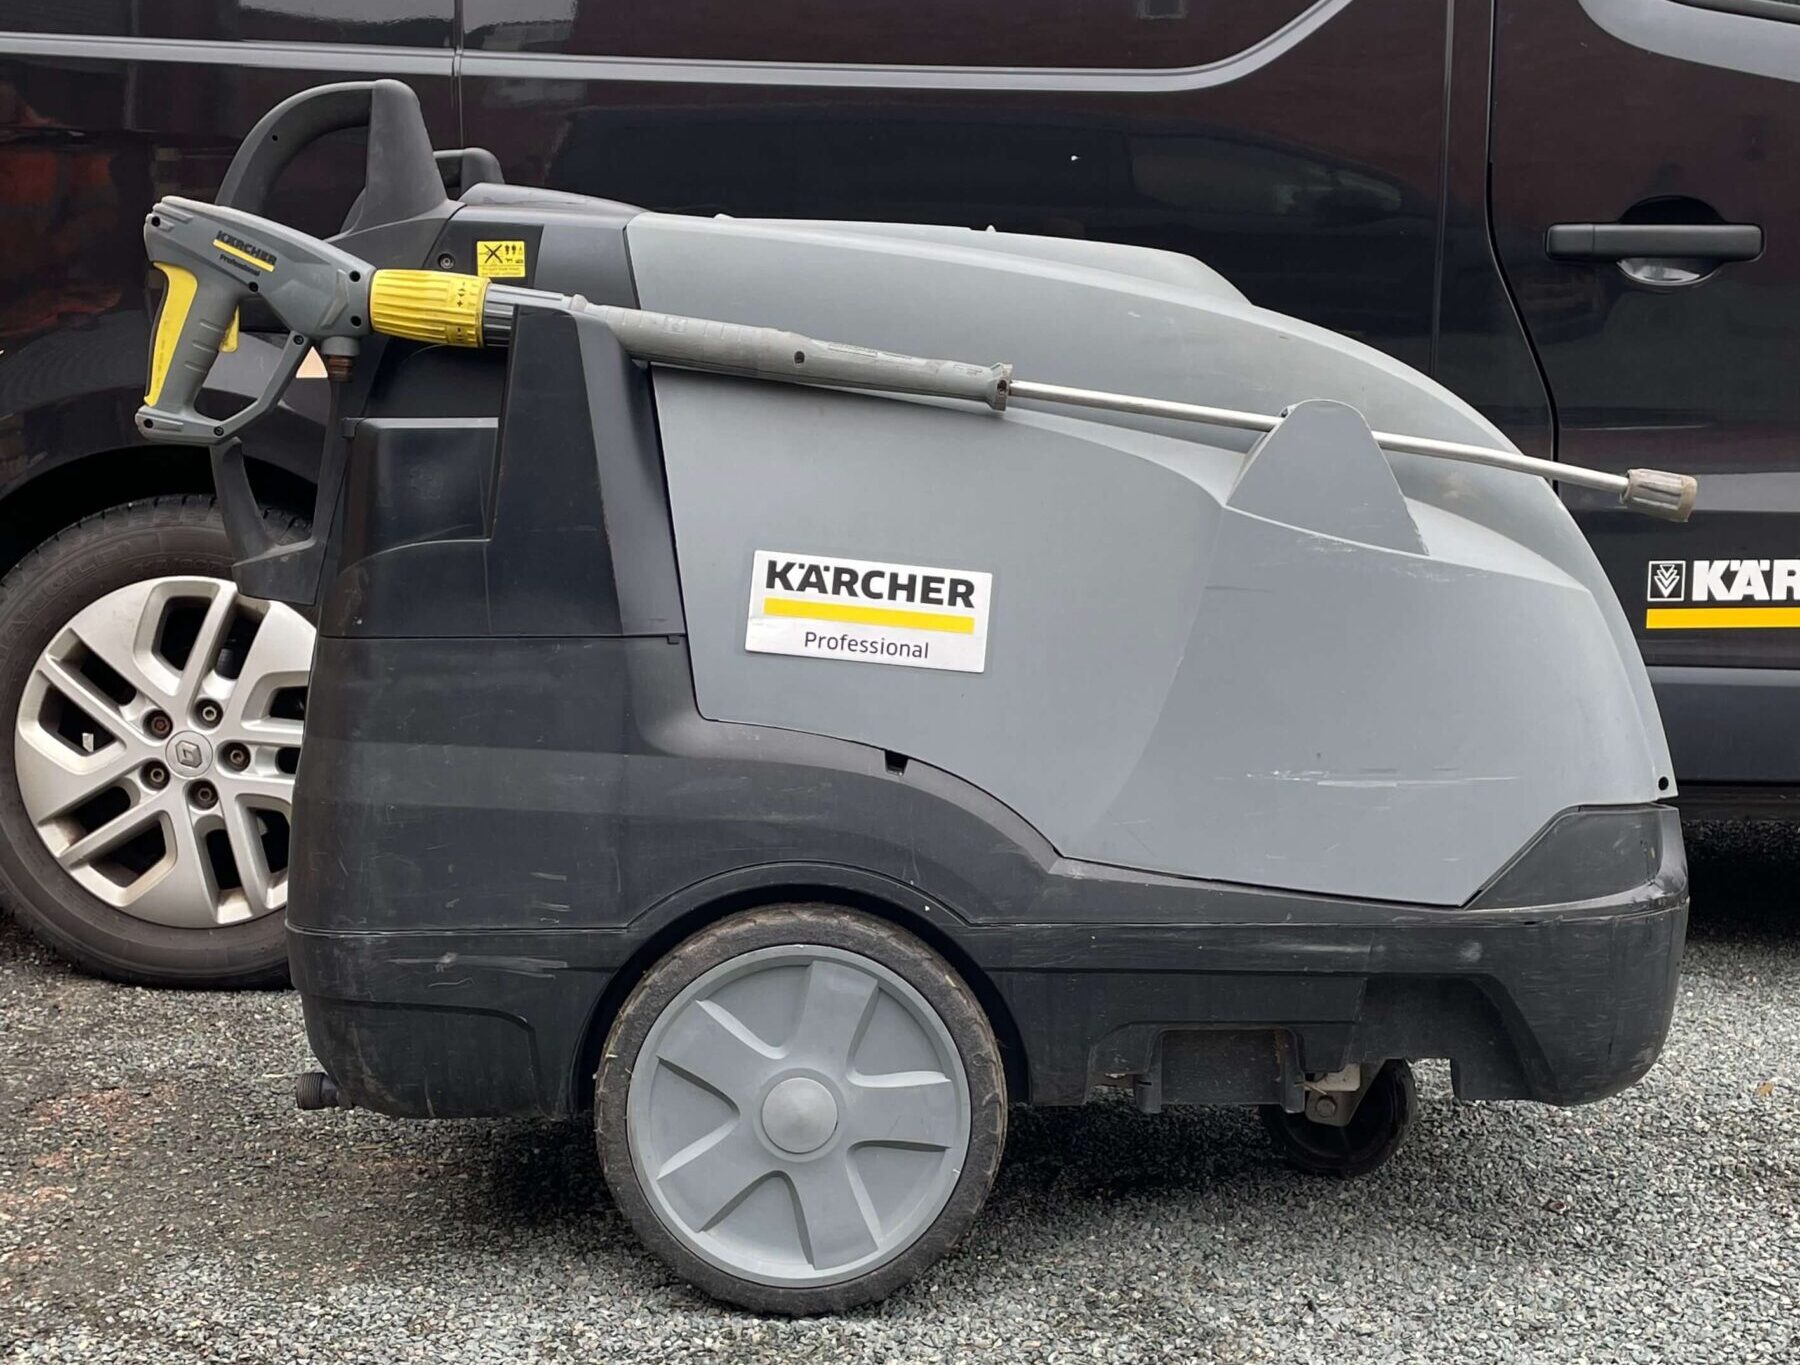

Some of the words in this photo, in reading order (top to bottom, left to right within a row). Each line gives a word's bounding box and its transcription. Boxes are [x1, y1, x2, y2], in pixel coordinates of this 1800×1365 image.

[215, 230, 277, 265] KÄRCHER
[765, 559, 976, 609] KÄRCHER
[804, 631, 929, 659] Professional
